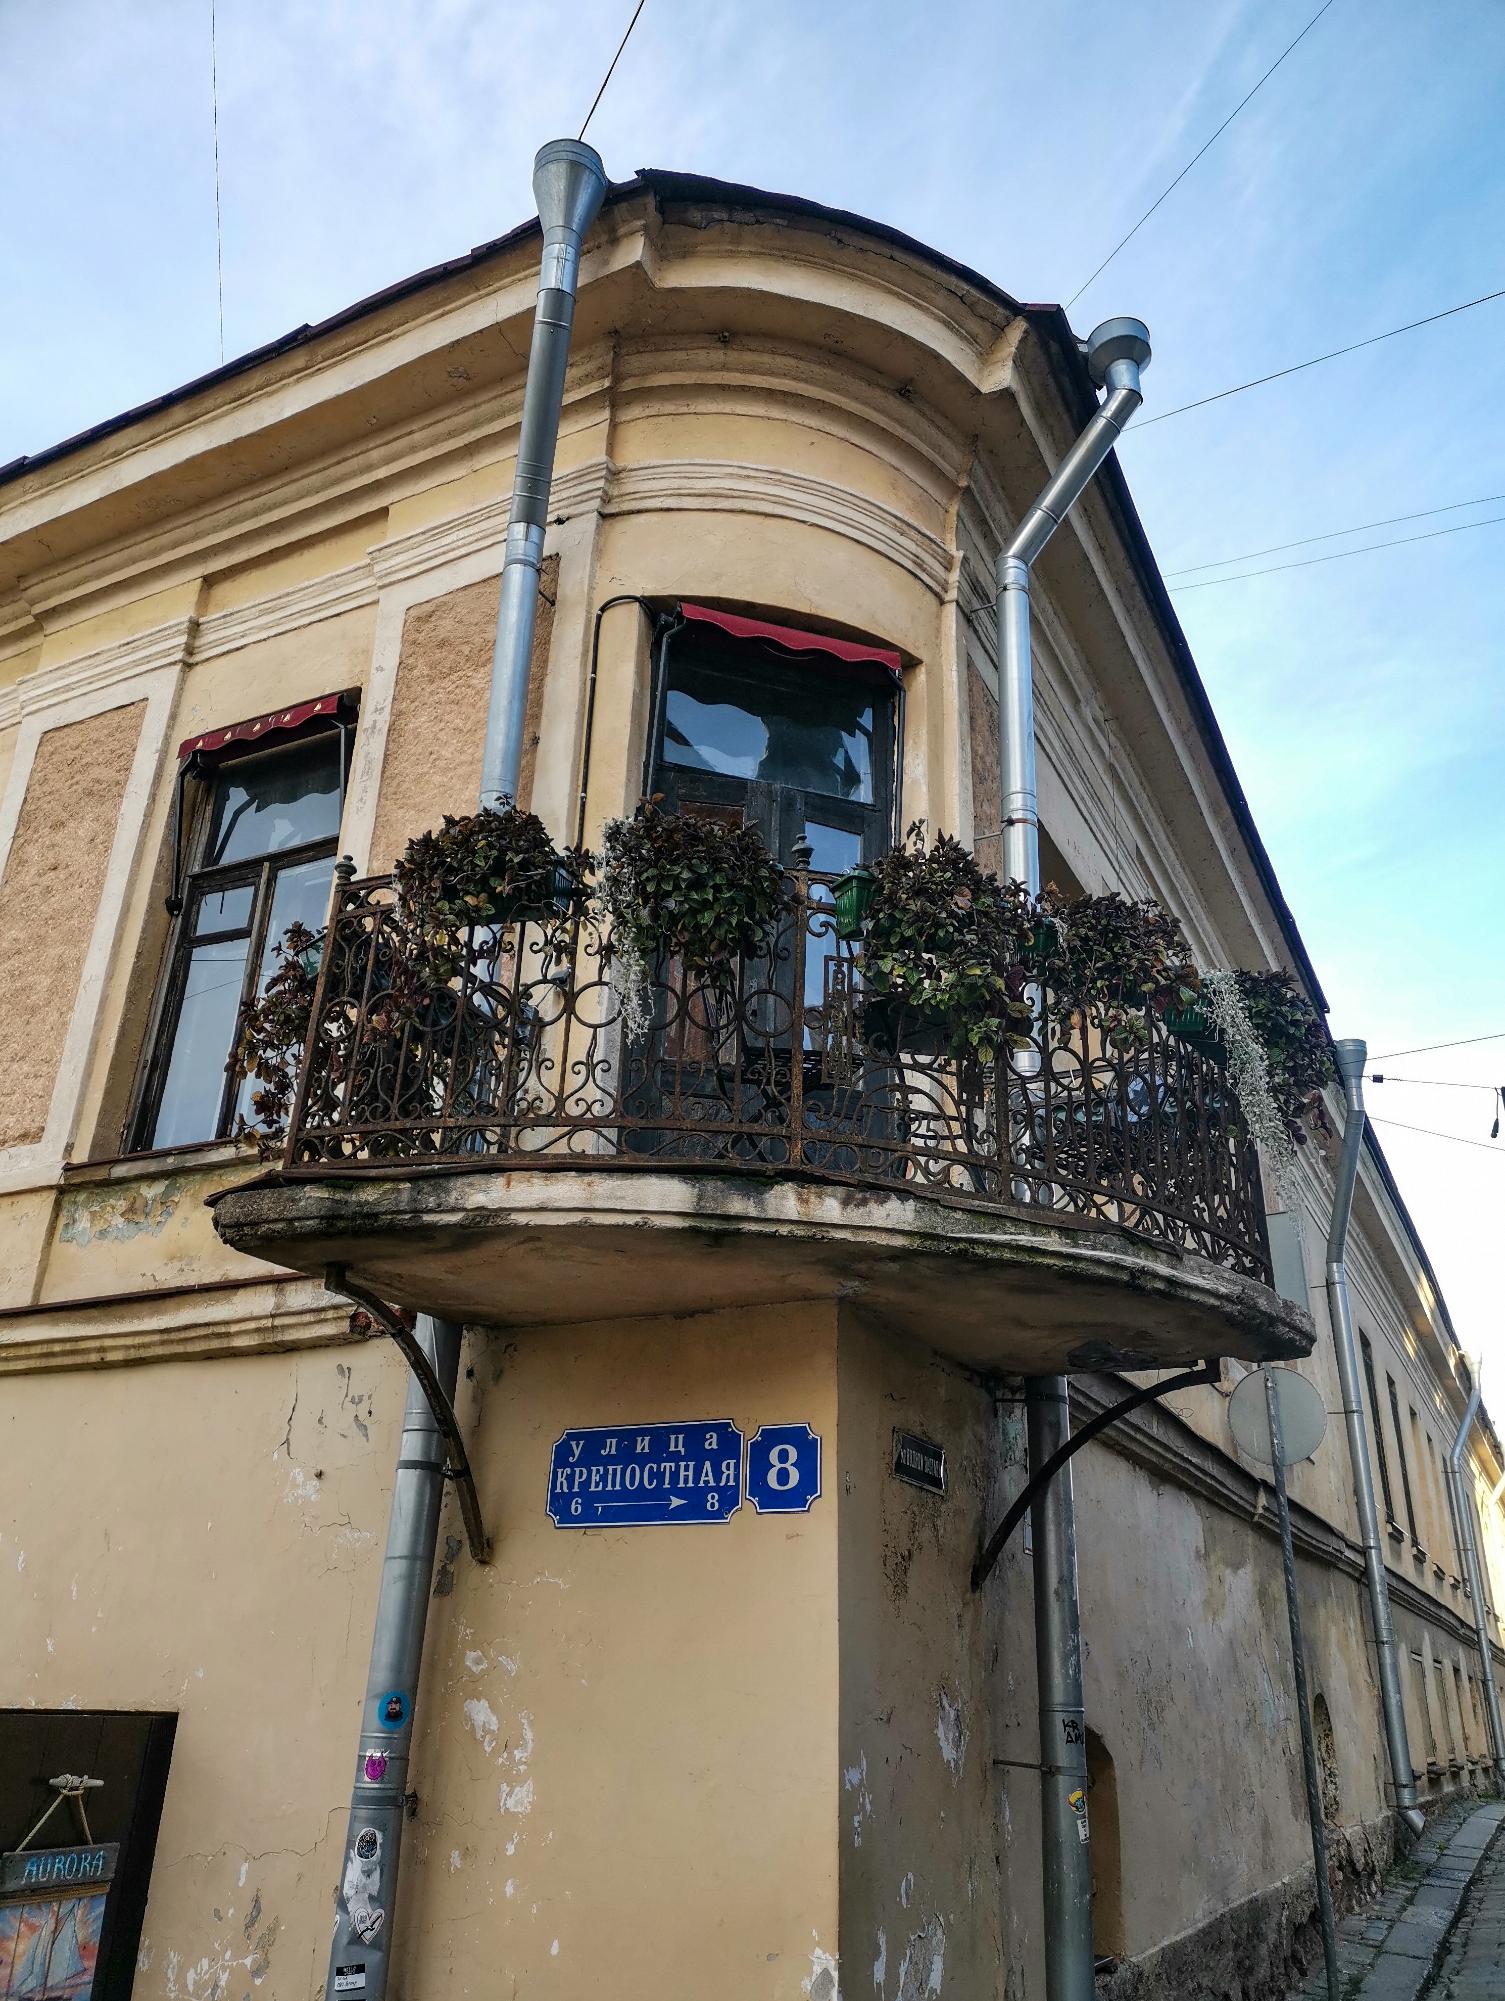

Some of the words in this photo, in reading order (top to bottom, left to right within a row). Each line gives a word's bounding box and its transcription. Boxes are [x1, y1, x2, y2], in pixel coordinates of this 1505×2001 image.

[568, 1431, 718, 1463] улица
[555, 1459, 737, 1493] КРЕПОСТНАЯ
[766, 1444, 800, 1490] 8
[570, 1498, 583, 1516] 6
[706, 1492, 720, 1511] 8
[21, 1850, 105, 1885] AURORA
